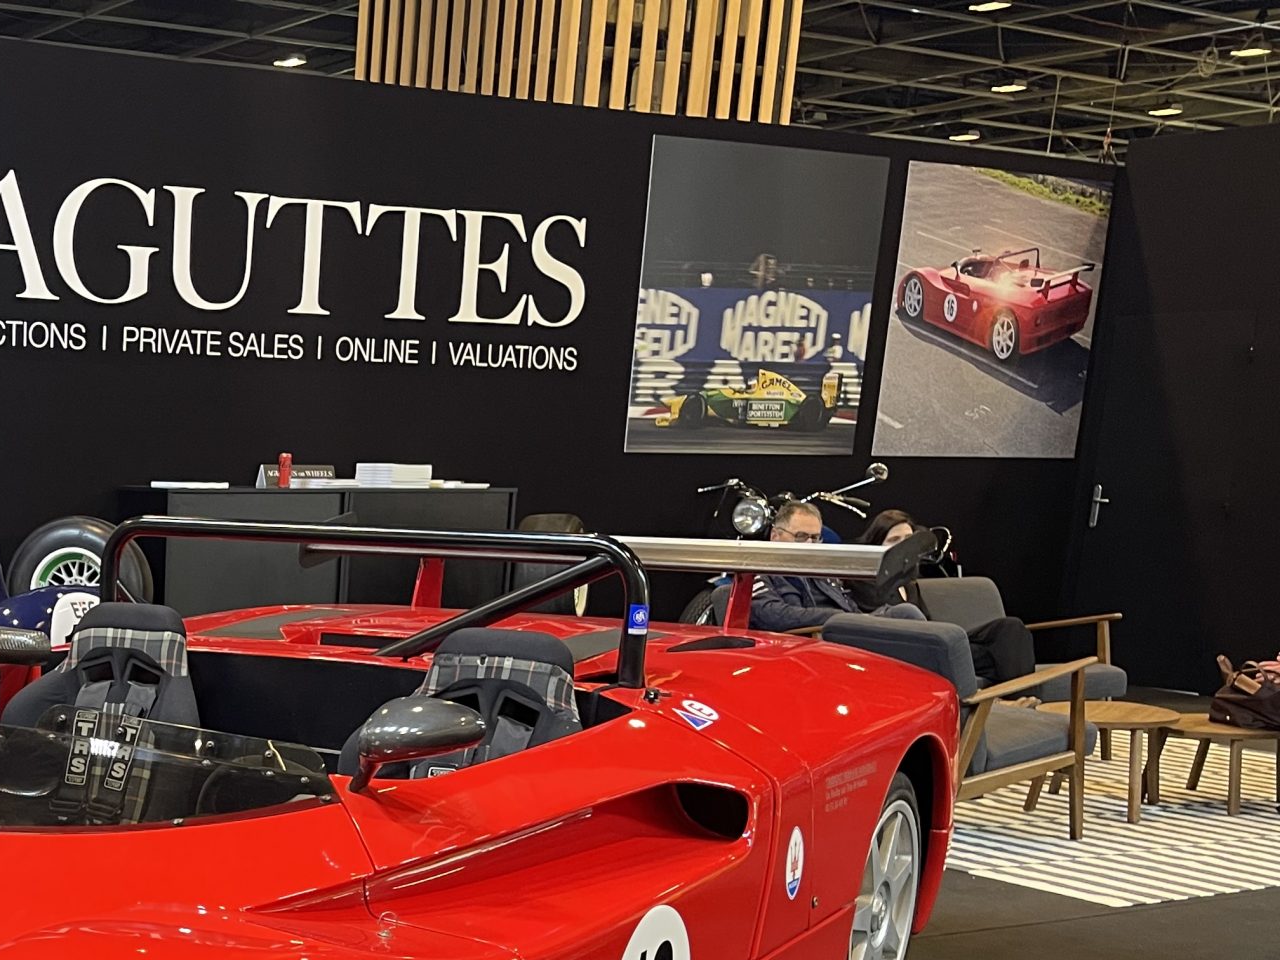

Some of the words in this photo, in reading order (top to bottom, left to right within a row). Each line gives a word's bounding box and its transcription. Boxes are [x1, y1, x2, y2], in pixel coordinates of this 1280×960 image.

[947, 300, 955, 317] 16
[122, 326, 221, 357] PRIVATE
[227, 331, 304, 360] SALES
[335, 335, 419, 365] ONLINE
[449, 341, 578, 371] VALUATIONS
[762, 378, 792, 392] CAMEL
